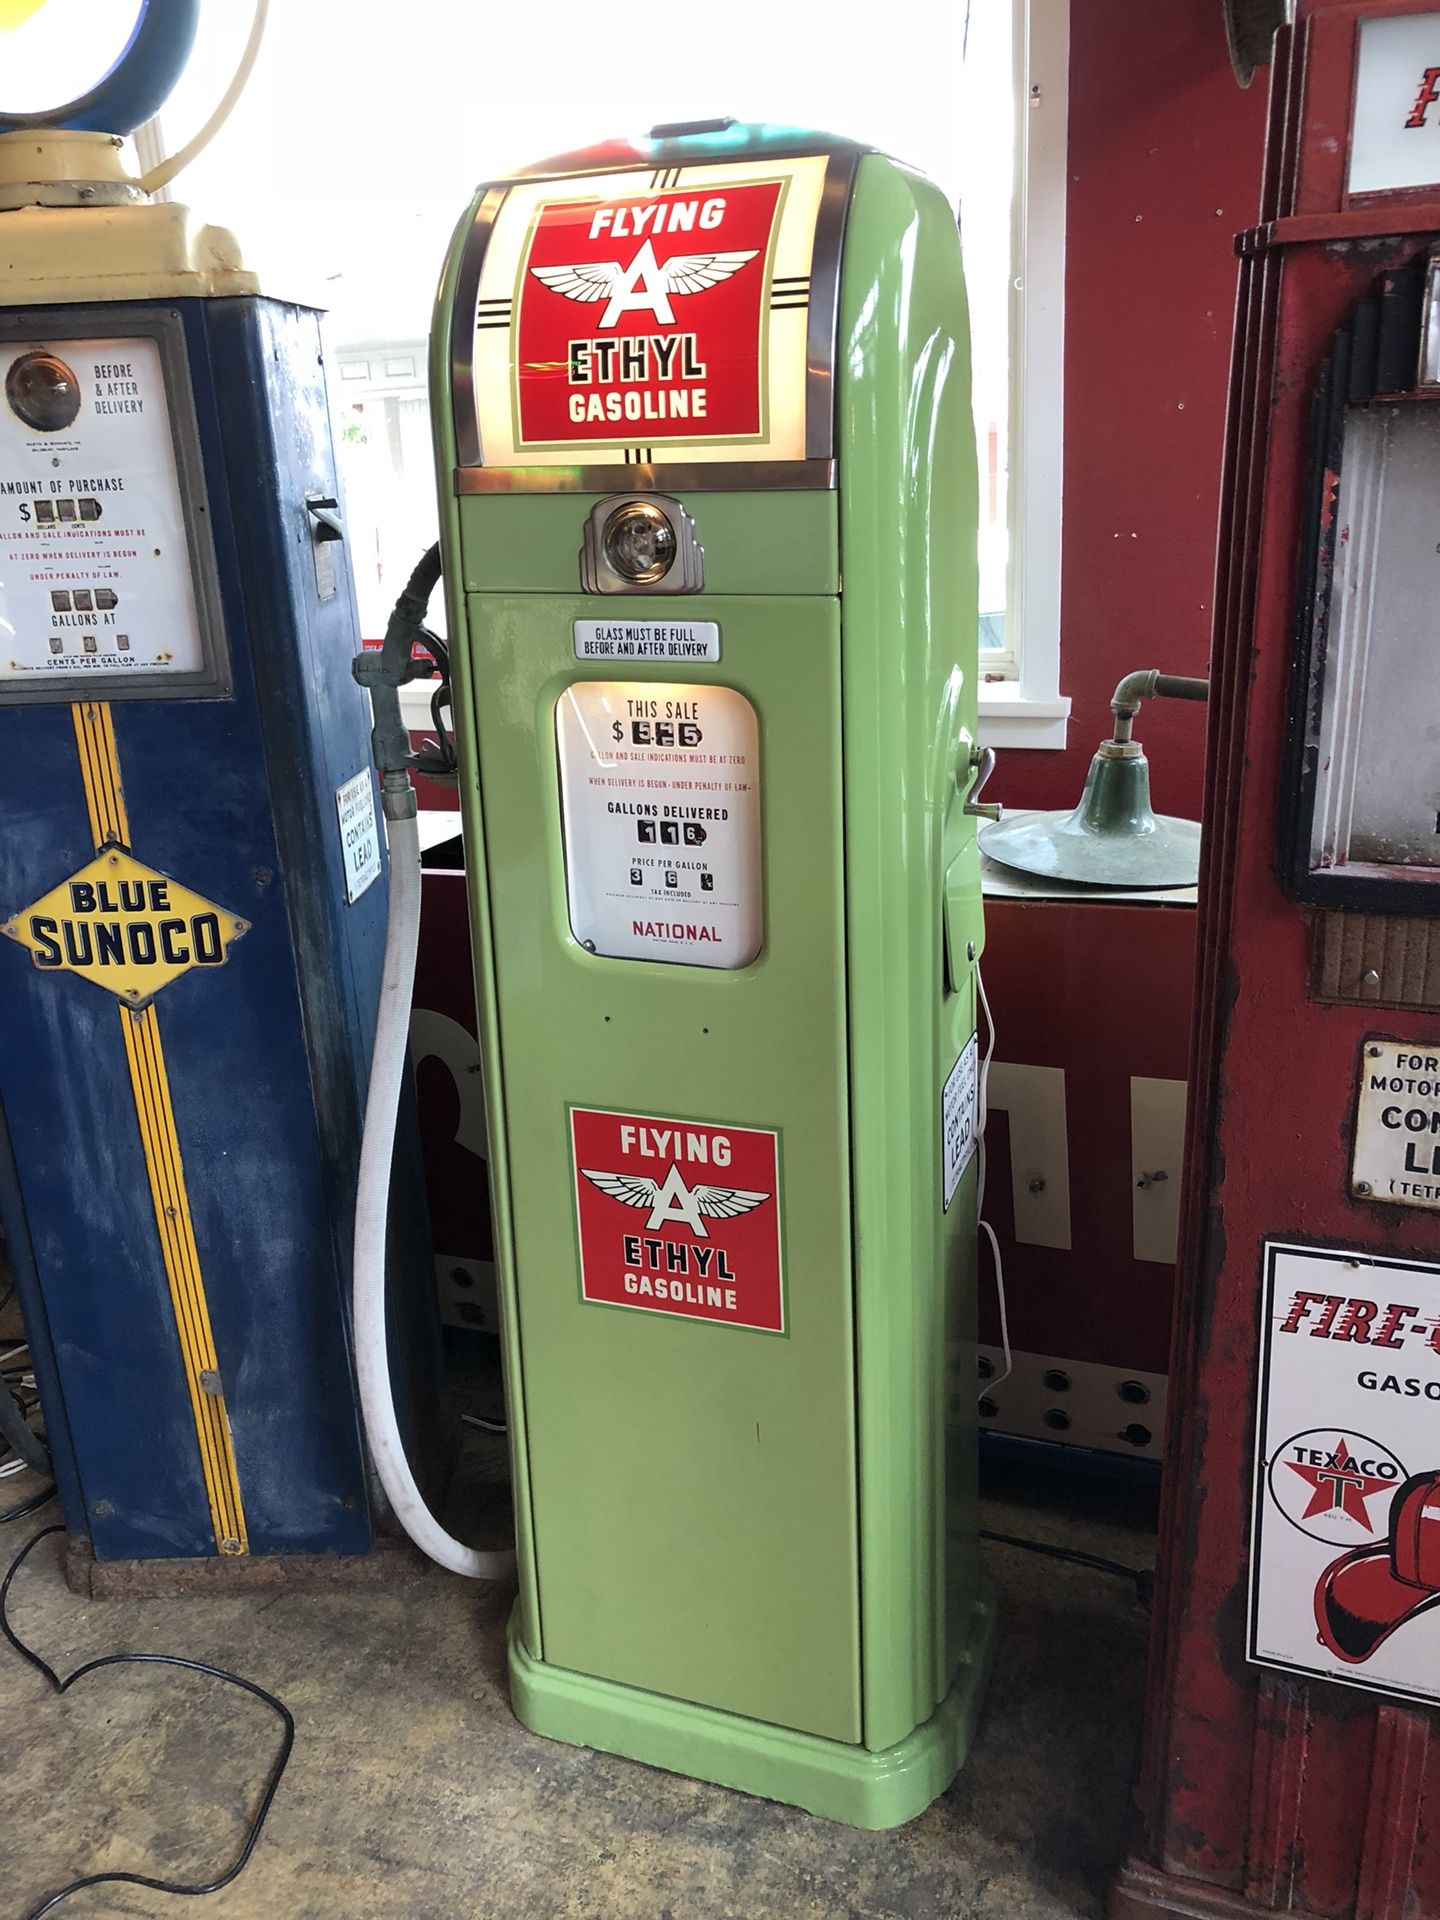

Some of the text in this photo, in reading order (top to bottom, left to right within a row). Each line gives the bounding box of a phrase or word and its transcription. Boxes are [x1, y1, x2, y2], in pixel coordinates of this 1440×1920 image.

[588, 197, 727, 240] FLYING
[597, 237, 677, 329] A
[568, 333, 706, 384] ETHYL
[94, 364, 132, 378] BEFORE
[95, 382, 139, 397] & AFTER
[94, 400, 144, 415] DELIVERY
[568, 388, 707, 423] GASOLINE
[0, 478, 124, 495] AMOUNT OF PURCHASE
[19, 502, 31, 522] $
[43, 531, 61, 539] SALE
[63, 530, 112, 538] INDICATIONS
[114, 529, 134, 537] MUST
[137, 528, 146, 536] BE
[21, 552, 39, 560] ZERO
[42, 551, 63, 560] WHEN
[65, 551, 100, 559] DELIVERY
[113, 550, 137, 558] BEGUN
[56, 572, 89, 580] PENALTY
[51, 613, 116, 627] GALLONS AT
[595, 627, 696, 641] GLASS MUST BE FULL
[584, 641, 708, 656] BEFORE AND AFTER DELIVERY
[47, 656, 135, 666] CENTS PER GALLON
[627, 699, 699, 720] THIS SALE
[612, 720, 624, 743] $
[616, 752, 628, 760] AND
[630, 753, 645, 761] SALE
[647, 753, 687, 762] INDICATIONS
[689, 754, 706, 763] MUST
[709, 755, 717, 764] BE
[719, 755, 727, 764] AT
[729, 756, 745, 764] ZERO
[588, 777, 606, 786] WHEN
[607, 778, 636, 787] DELIVERY
[638, 779, 645, 788] IS
[695, 782, 722, 791] PENALTY
[724, 783, 732, 791] OF
[607, 801, 728, 821] GALLONS DELIVERED
[353, 839, 372, 873] LEAD
[632, 857, 708, 871] PRICE PER GALLON
[69, 880, 171, 913] BLUE
[663, 890, 691, 898] INCLUDED
[30, 912, 224, 966] SUNOCO
[632, 920, 722, 942] NATIONAL
[1396, 1053, 1438, 1072] FOR
[947, 1084, 975, 1146] CONTAINS
[620, 1124, 732, 1167] FLYING
[951, 1117, 970, 1170] LEAD
[644, 1161, 711, 1239] A
[623, 1234, 736, 1282] ETHYL
[623, 1273, 737, 1311] GASOLINE
[1278, 1290, 1440, 1356] FIRE-
[1293, 1446, 1398, 1479] TEXACO
[1317, 1471, 1364, 1508] T
